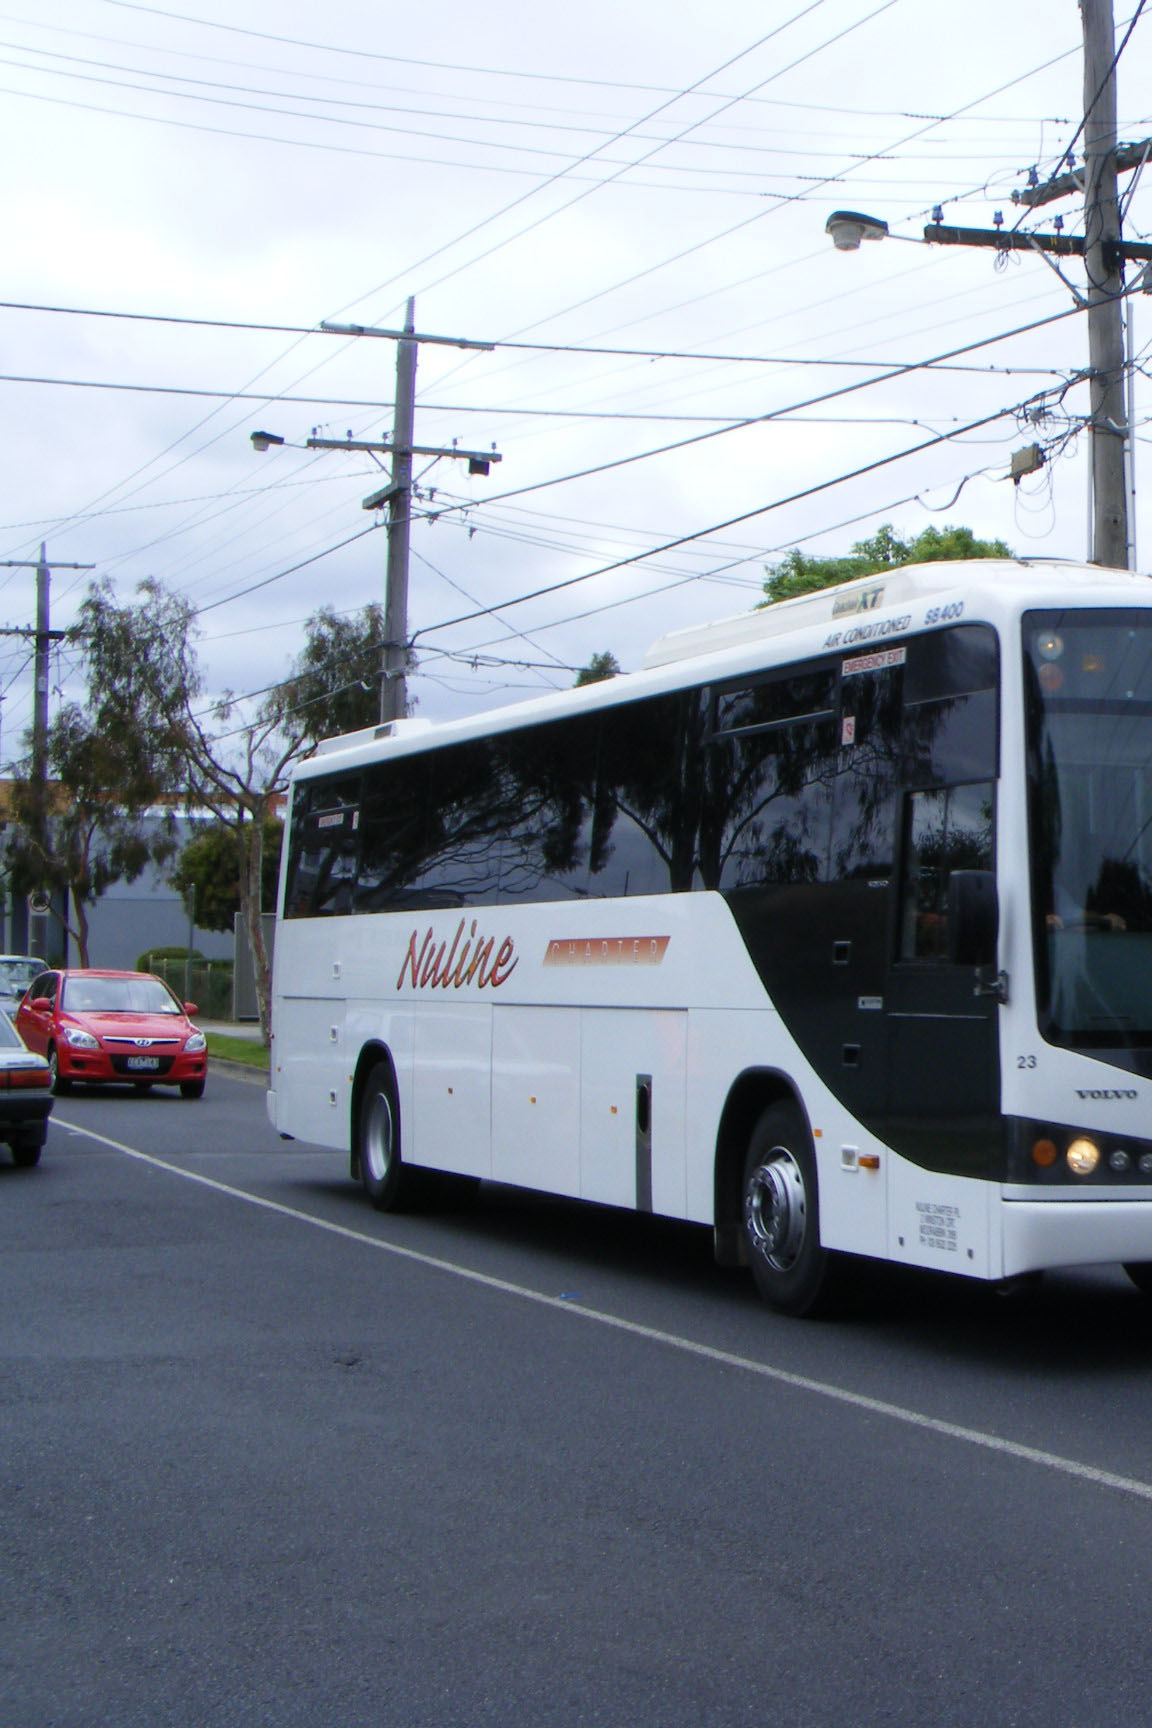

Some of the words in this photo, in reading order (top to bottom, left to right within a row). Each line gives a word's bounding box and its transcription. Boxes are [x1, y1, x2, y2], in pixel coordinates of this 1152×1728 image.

[823, 632, 842, 649] AIR
[843, 614, 912, 644] CONDITIONED
[844, 653, 886, 674] EMERGENCY
[887, 649, 905, 665] EXIT
[396, 917, 519, 990] Nuline
[1017, 1055, 1038, 1069] 23
[1074, 1089, 1138, 1100] VOLVO
